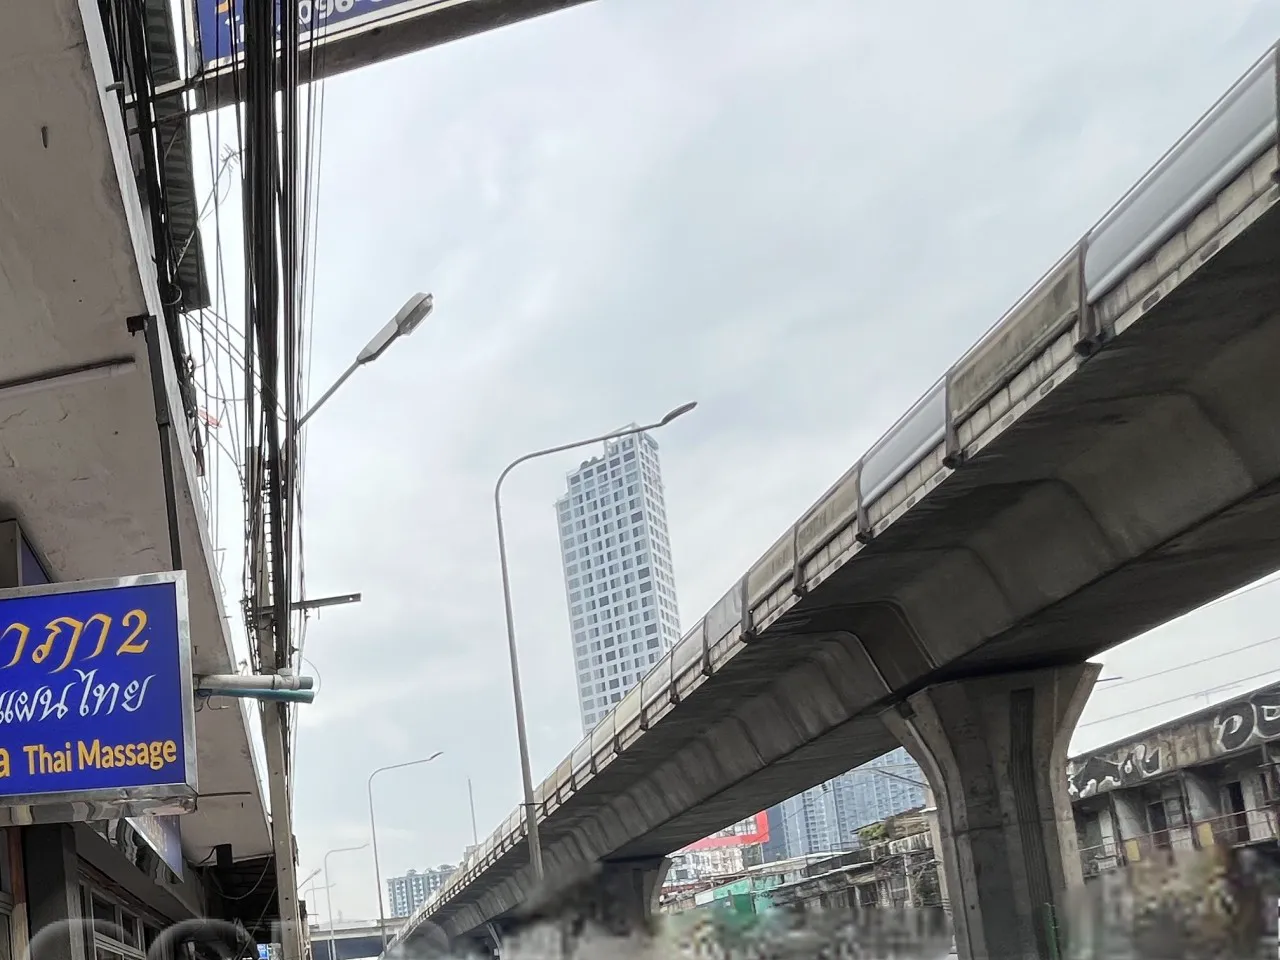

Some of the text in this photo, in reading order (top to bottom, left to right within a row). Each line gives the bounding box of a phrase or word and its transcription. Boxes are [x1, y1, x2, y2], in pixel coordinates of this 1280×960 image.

[116, 609, 151, 656] 2
[23, 742, 72, 776] Thai
[78, 738, 178, 772] Massage
